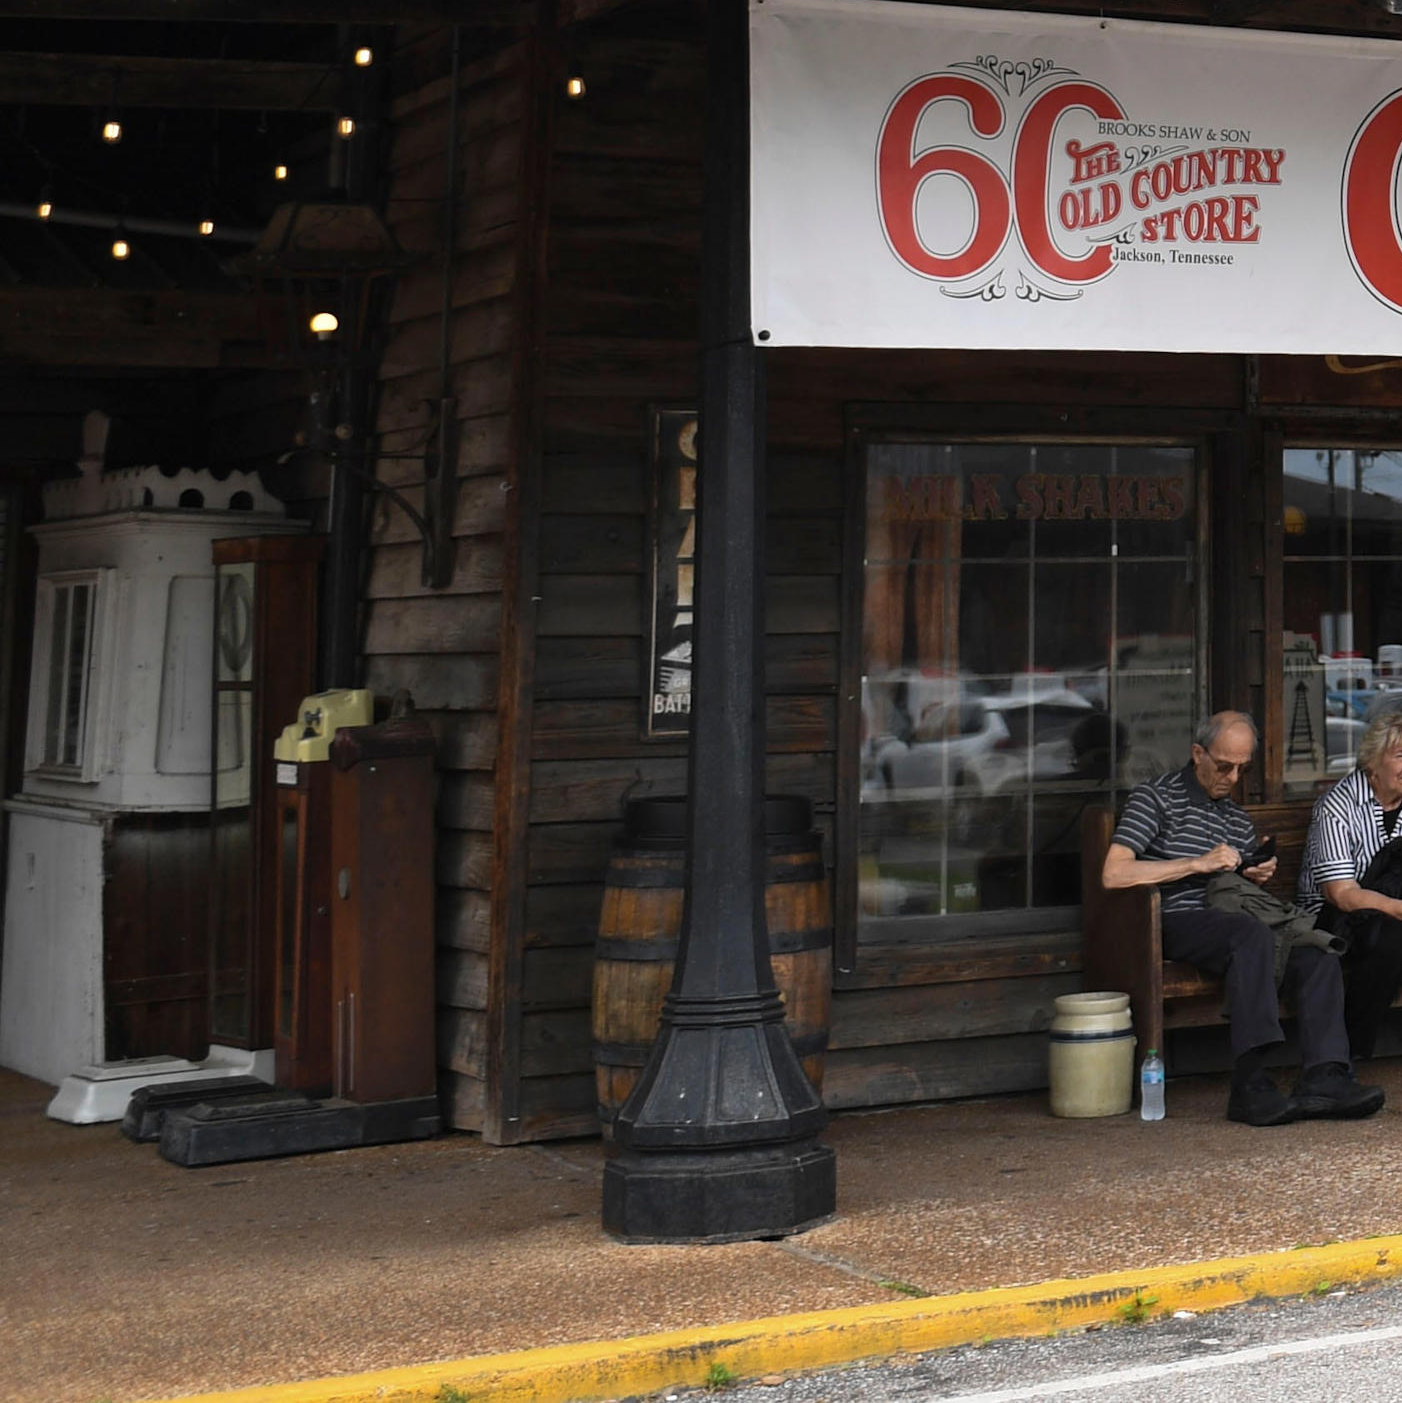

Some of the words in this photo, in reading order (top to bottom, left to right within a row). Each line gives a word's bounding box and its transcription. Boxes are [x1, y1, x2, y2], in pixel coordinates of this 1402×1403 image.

[1098, 121, 1156, 138] BROOKS
[1159, 125, 1204, 141] SHAW
[1206, 129, 1218, 142] &
[1220, 129, 1251, 143] SON
[874, 72, 1128, 284] 60
[1065, 139, 1122, 184] THE
[1059, 180, 1123, 231] OLD
[1130, 148, 1286, 210] COUNTRY
[1141, 195, 1260, 243] STORE
[1112, 249, 1165, 265] Jackson,
[1169, 249, 1235, 266] Tennessee
[884, 473, 1008, 521] MILK
[1016, 473, 1188, 521] SHAKES
